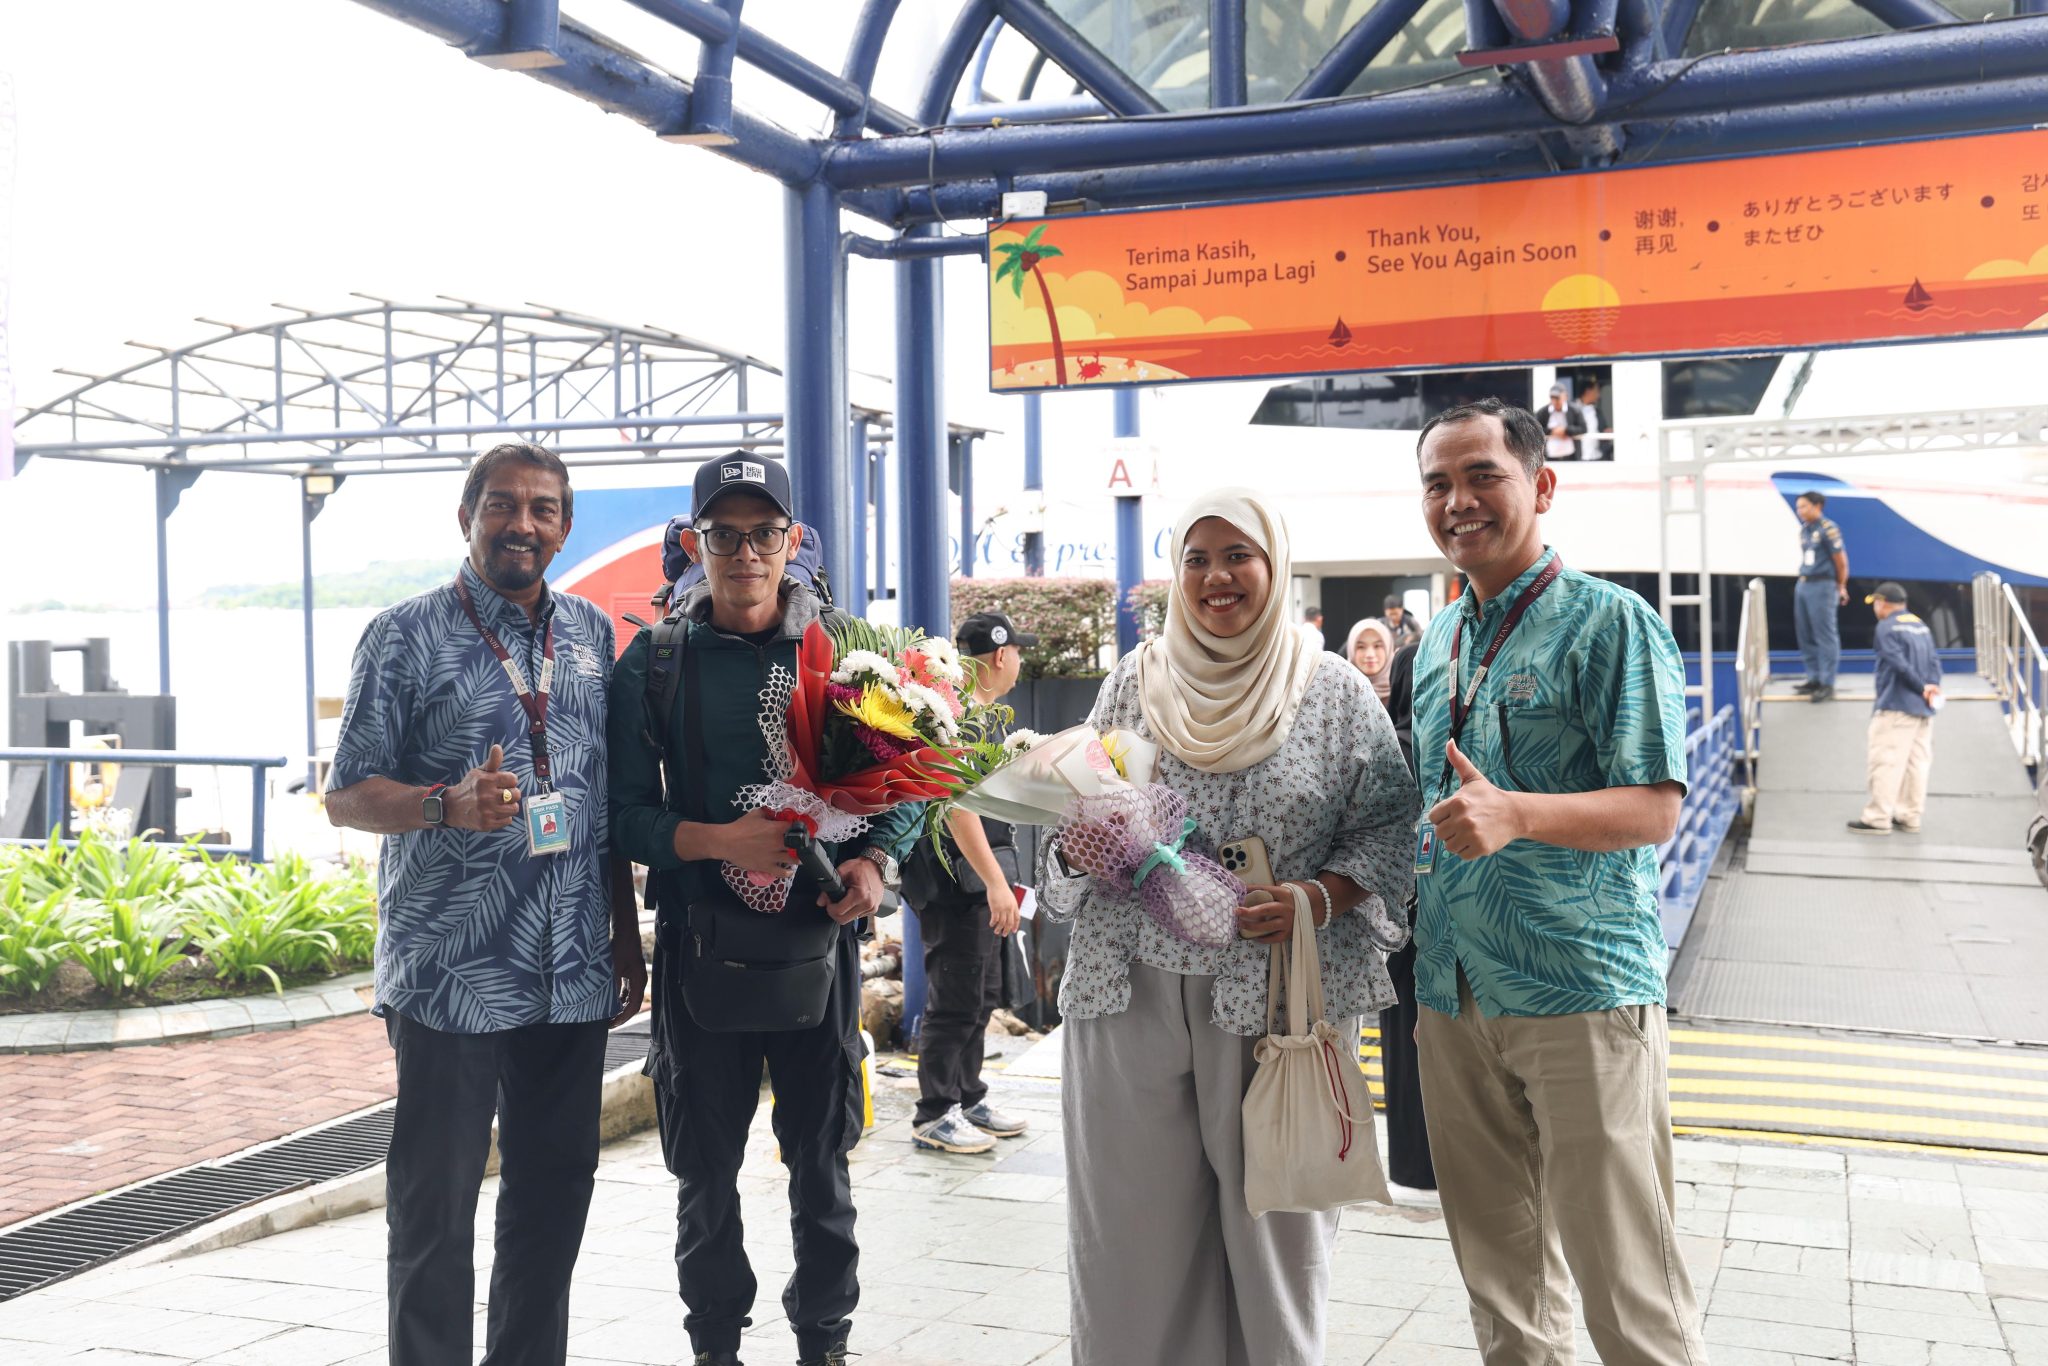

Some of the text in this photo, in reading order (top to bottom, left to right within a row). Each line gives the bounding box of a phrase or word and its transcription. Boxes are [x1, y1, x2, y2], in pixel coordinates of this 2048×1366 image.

[1743, 183, 1954, 218] ありがとうございます
[2021, 203, 2041, 221] 또
[1634, 207, 1684, 230] 谢谢,
[1367, 223, 1480, 248] Thank You,
[1634, 233, 1678, 256] 再见
[1744, 224, 1825, 247] またぜひ
[1126, 239, 1256, 266] Terima Kasih,
[1367, 243, 1577, 274] See You Again Soon
[1126, 260, 1316, 293] Sampai Jumpa Lagi
[746, 465, 762, 474] NEW
[1108, 459, 1132, 488] A
[1530, 568, 1555, 595] BINTAN
[1490, 622, 1511, 652] BINTAN
